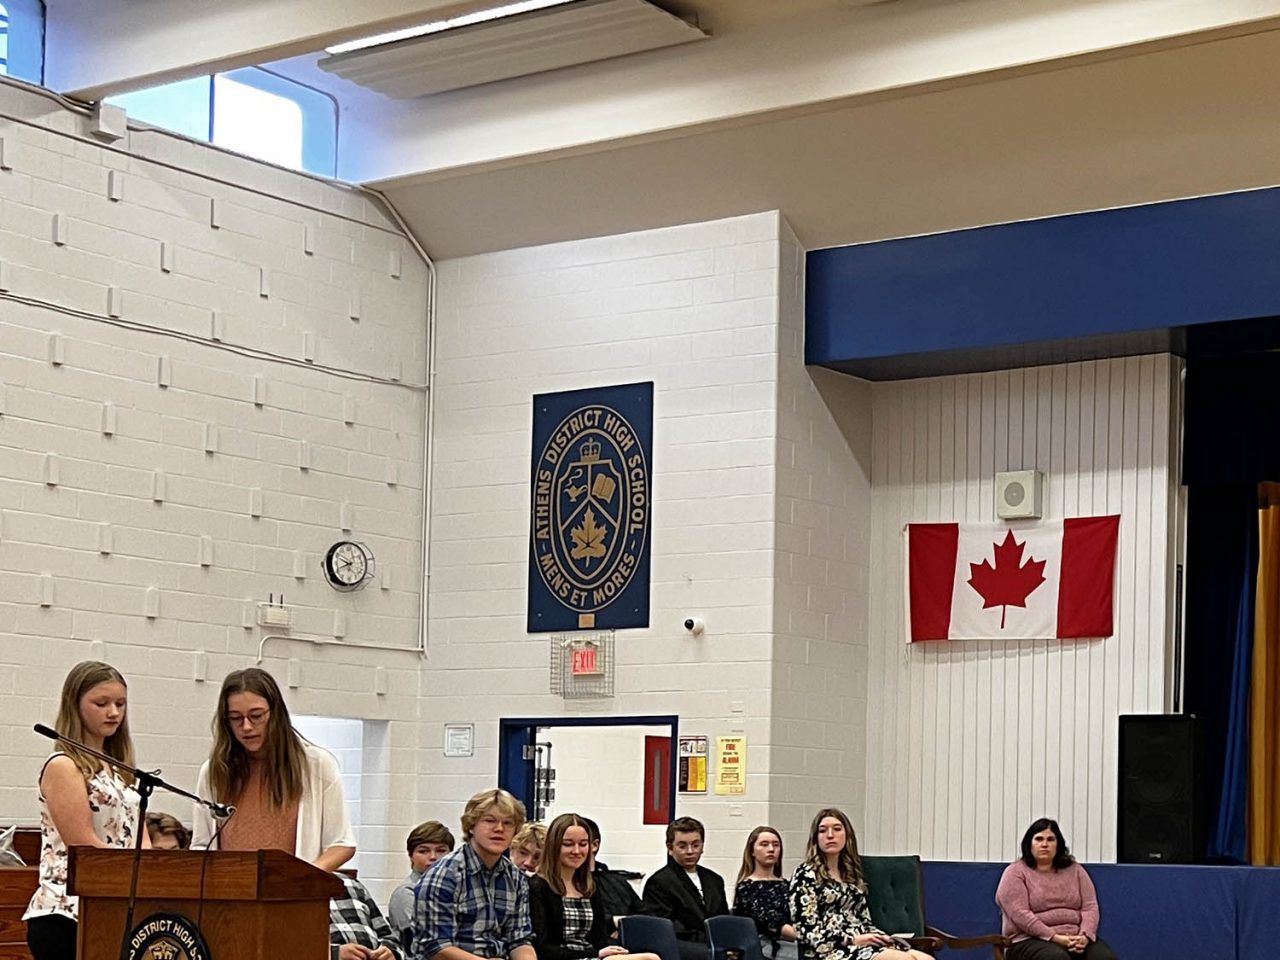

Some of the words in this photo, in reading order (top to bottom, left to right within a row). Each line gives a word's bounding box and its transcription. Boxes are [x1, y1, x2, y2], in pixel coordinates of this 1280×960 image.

[536, 470, 552, 539] ATHENS
[545, 410, 602, 465] DISTRICT
[603, 414, 635, 452] HIGH
[628, 454, 645, 534] SCHOOL
[541, 553, 569, 598] MENS
[570, 590, 587, 607] ET
[592, 552, 635, 607] MORES
[573, 651, 596, 672] EXIT
[131, 920, 172, 949] DISTRICT
[173, 923, 195, 948] HIGH
